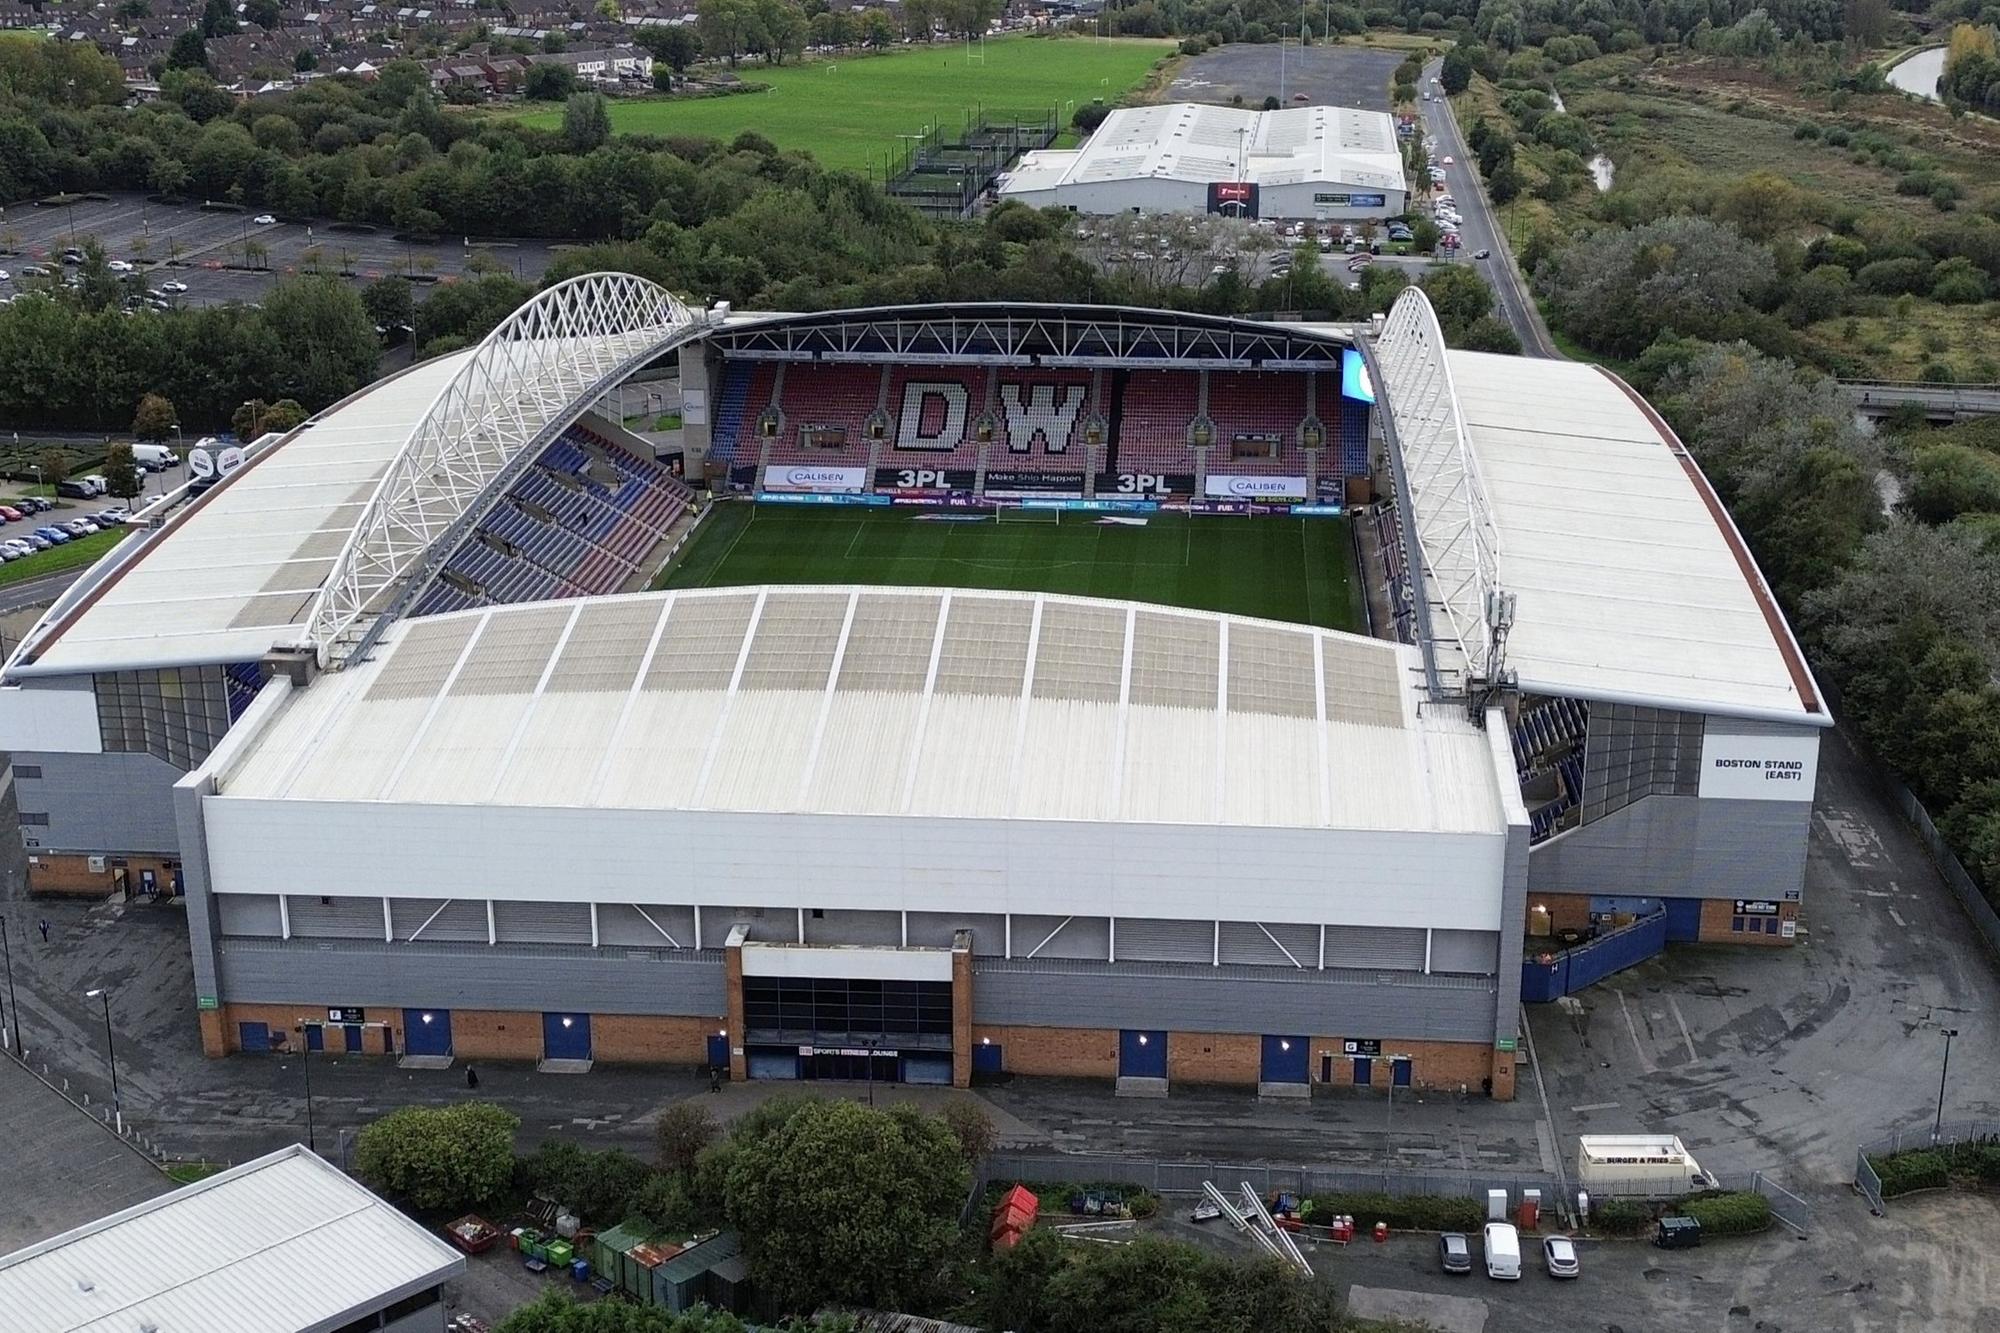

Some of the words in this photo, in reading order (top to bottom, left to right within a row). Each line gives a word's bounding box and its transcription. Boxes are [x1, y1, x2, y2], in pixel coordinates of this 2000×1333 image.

[897, 382, 968, 449] D
[1001, 384, 1085, 452] W
[794, 473, 844, 481] CALISEN
[897, 470, 951, 488] 3PL
[988, 473, 1015, 481] Make
[1042, 474, 1082, 483] Happen
[1117, 474, 1172, 493] 3PL
[1236, 482, 1286, 491] CALISEN
[818, 495, 834, 503] FUEL
[950, 498, 967, 506] FUEL
[1217, 504, 1235, 512] FUEL
[1715, 759, 1761, 769] BOSTON
[1764, 760, 1803, 770] STAND
[1765, 771, 1801, 781] (EAST)
